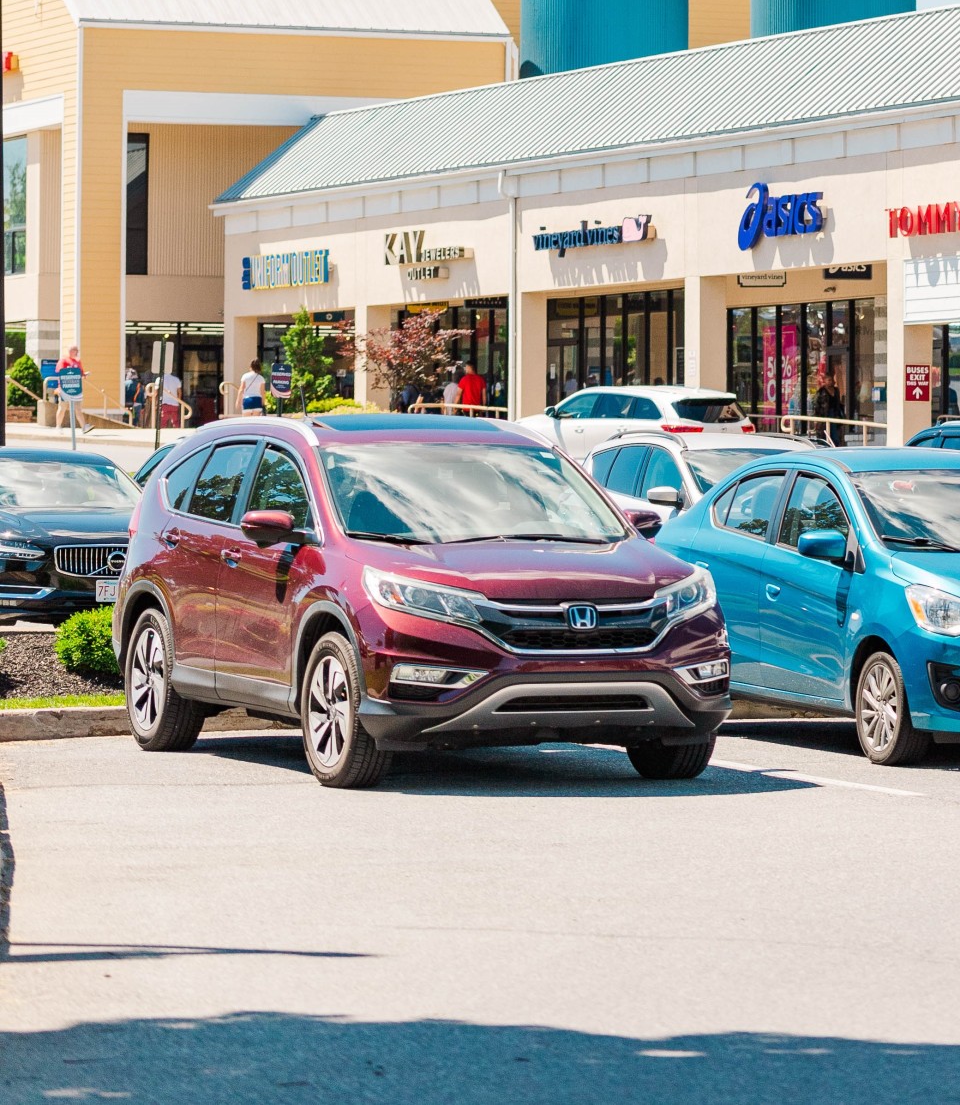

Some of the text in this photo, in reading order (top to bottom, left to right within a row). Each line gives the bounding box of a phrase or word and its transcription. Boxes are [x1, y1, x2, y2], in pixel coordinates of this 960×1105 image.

[384, 230, 425, 265] KAY
[532, 220, 622, 257] vineyard vines
[421, 246, 462, 262] JEWELERS
[251, 255, 290, 290] UNIFORM
[291, 249, 329, 287] OUTLET
[407, 266, 438, 281] OUTLET
[742, 273, 767, 281] vineyard
[767, 355, 792, 378] 5%
[906, 366, 929, 374] BUSES
